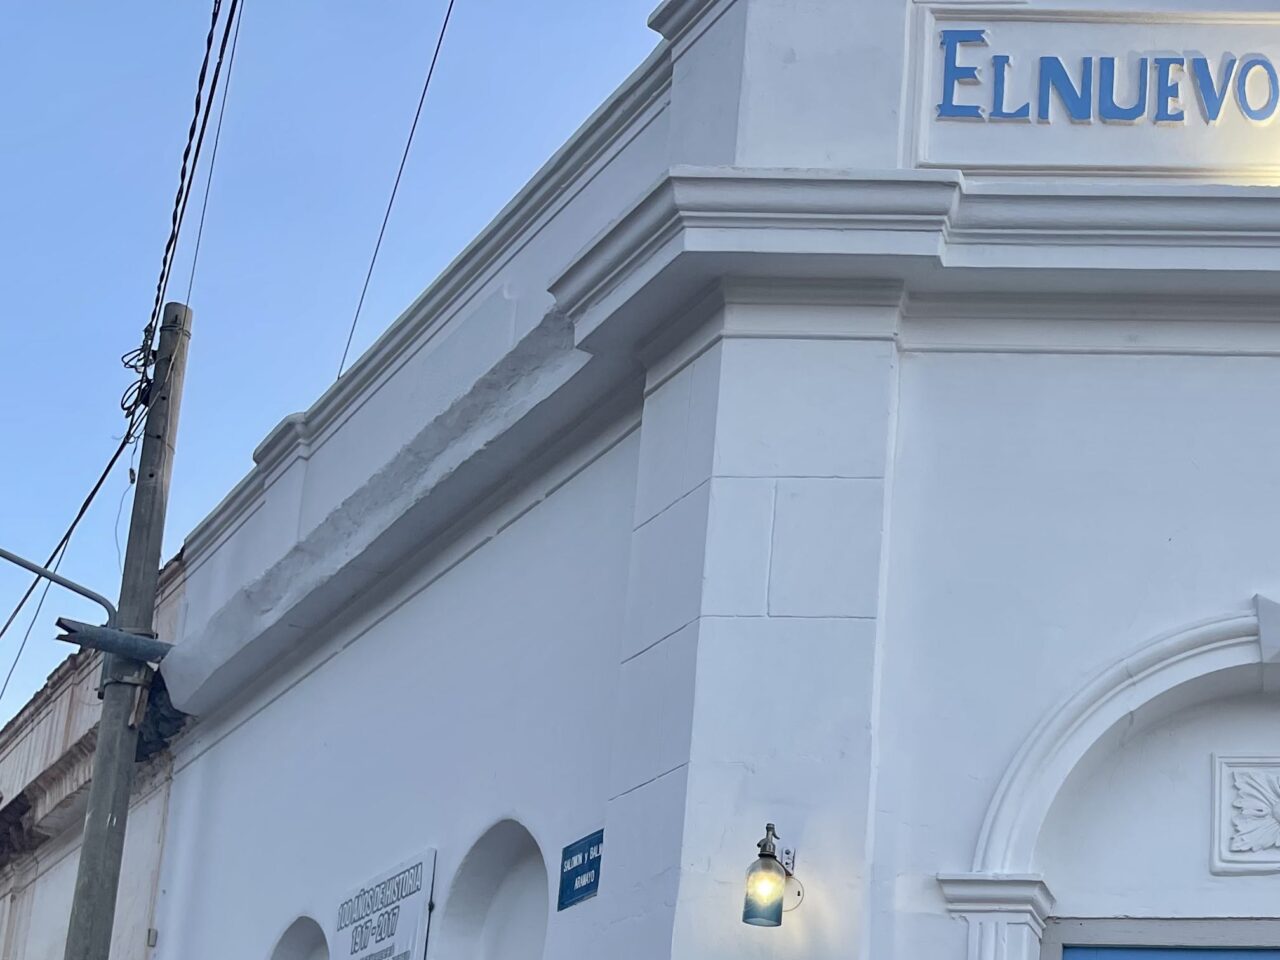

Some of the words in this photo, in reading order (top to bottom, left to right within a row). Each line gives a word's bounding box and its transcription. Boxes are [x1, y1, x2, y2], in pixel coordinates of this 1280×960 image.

[337, 898, 353, 932] 100
[350, 888, 375, 926] AÑOS
[371, 879, 389, 914] DE
[385, 862, 422, 906] HISTORIA
[350, 918, 372, 955] 1917
[375, 905, 400, 944] 2017
